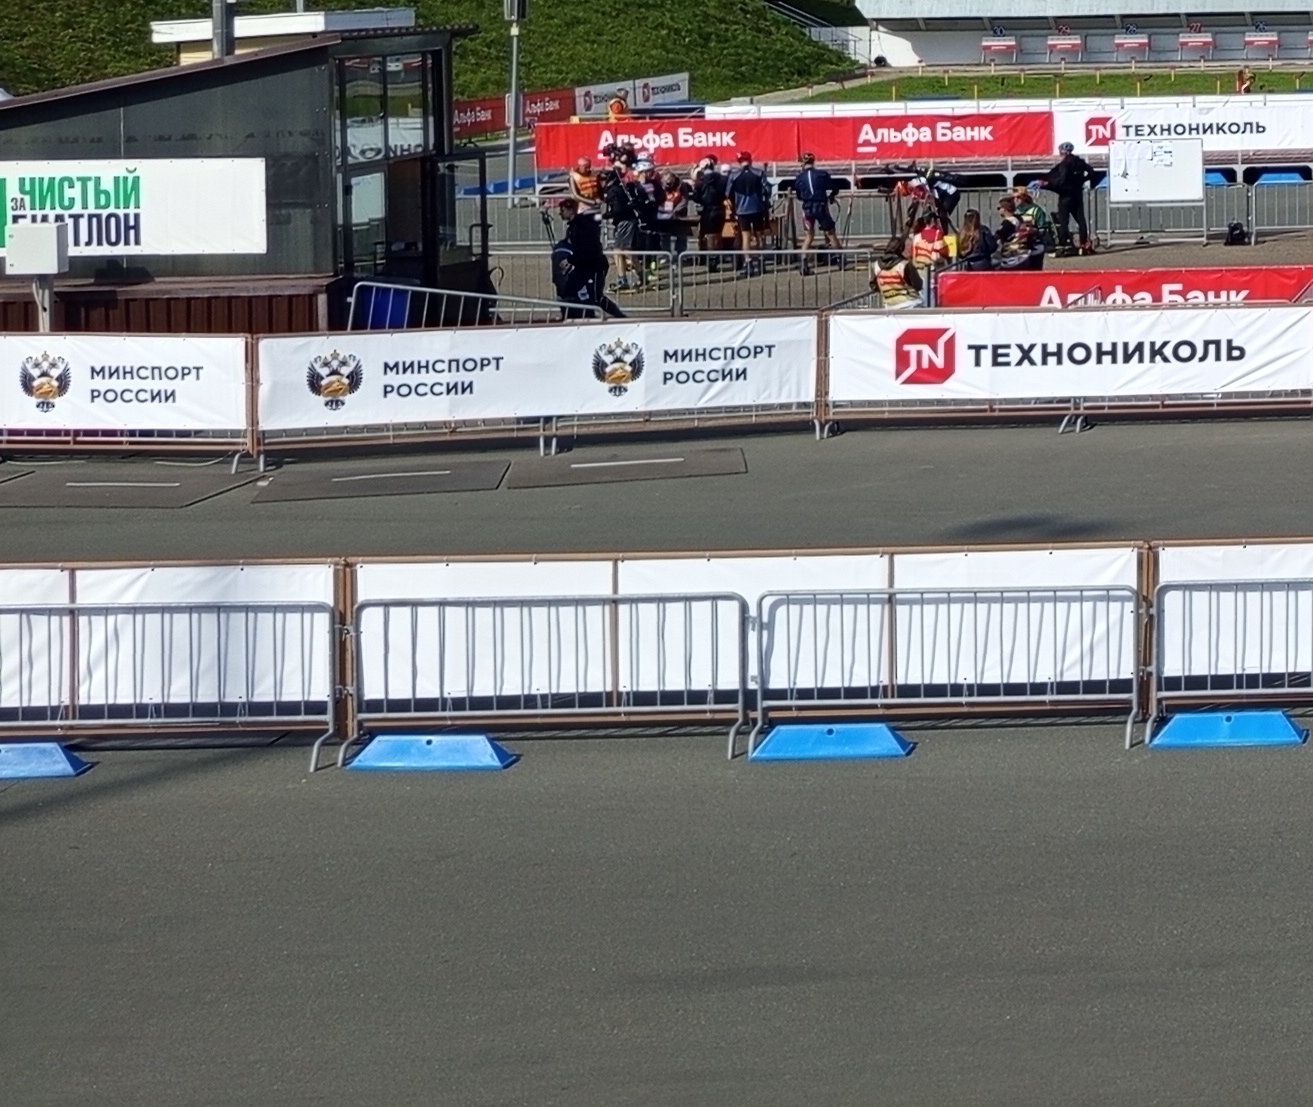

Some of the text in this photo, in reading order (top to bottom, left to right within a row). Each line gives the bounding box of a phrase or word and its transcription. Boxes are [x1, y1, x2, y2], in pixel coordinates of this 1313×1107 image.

[678, 127, 737, 148] Банк
[858, 122, 994, 147] Альфа Банк
[1122, 120, 1266, 138] ТЕХНОНИКОЛЬ
[10, 167, 140, 212] ЗА ЧИСТЫЙ
[12, 213, 141, 247] ТЛОН
[663, 344, 776, 364] МИНСПОРТ
[968, 339, 1246, 368] ТЕХНОНИКОЛЬ
[90, 365, 204, 382] МИНСПОРТ
[383, 356, 504, 376] МИНСПОРТ
[662, 368, 748, 386] РОССИИ
[90, 388, 176, 404] РОССИИ
[383, 380, 474, 398] РОССИИ
